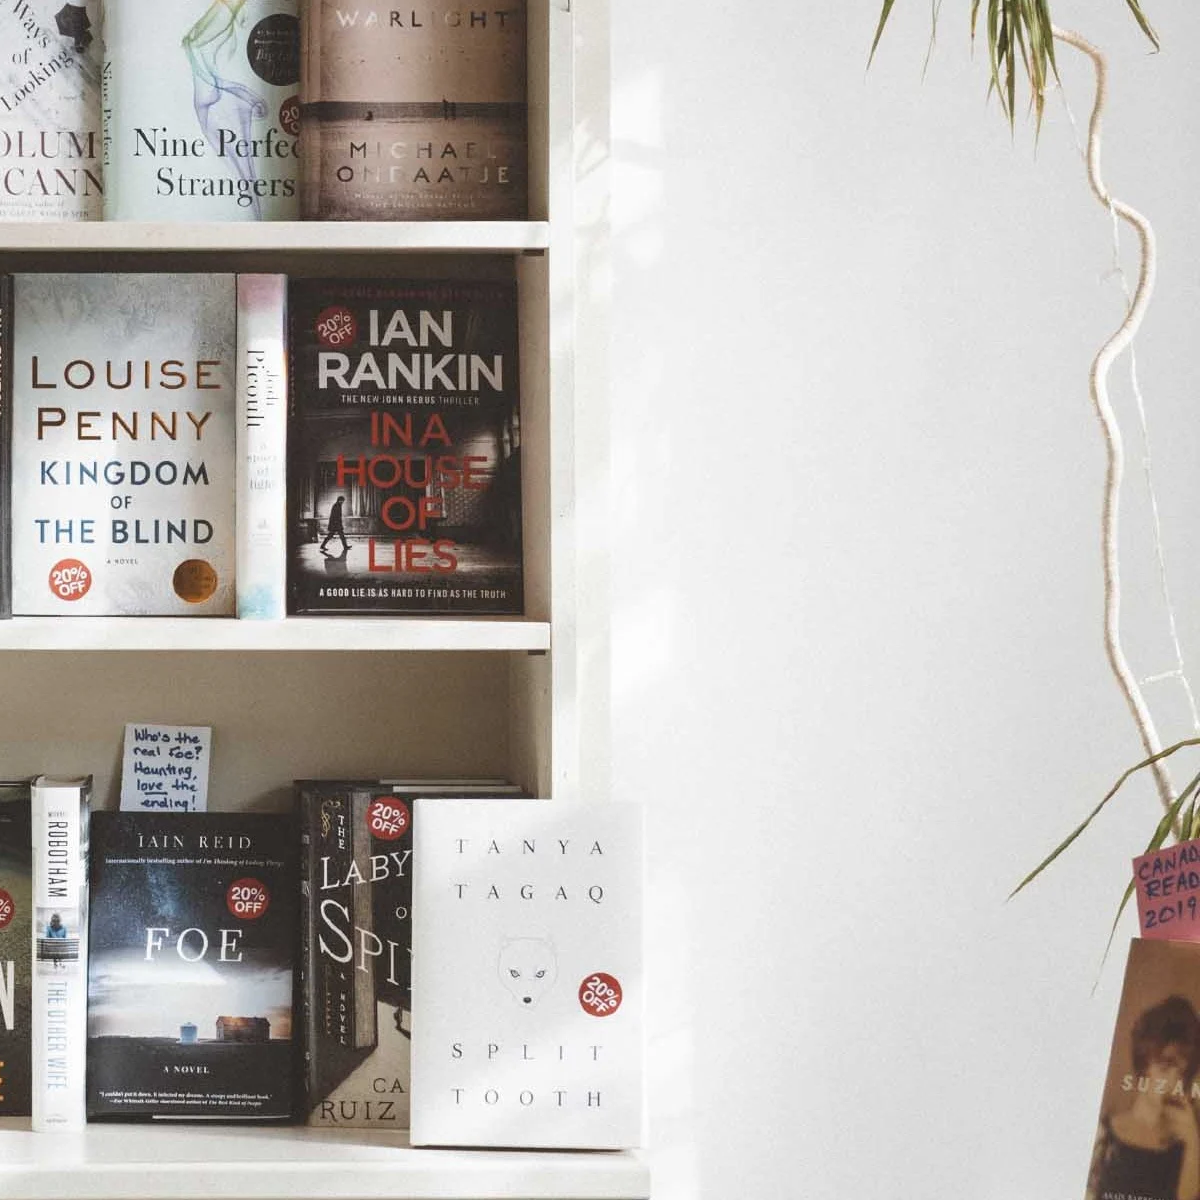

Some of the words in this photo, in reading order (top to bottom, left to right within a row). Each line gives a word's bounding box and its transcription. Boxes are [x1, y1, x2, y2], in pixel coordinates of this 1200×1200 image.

[12, 46, 31, 65] of
[0, 48, 75, 112] Looking
[133, 127, 206, 157] Nine
[217, 128, 300, 158] Perfec
[157, 166, 296, 206] Strangers
[369, 309, 452, 347] IAN
[32, 356, 222, 390] LOUISE
[318, 352, 503, 391] RANKIN
[37, 407, 213, 441] PENNY
[371, 411, 412, 447] IN
[420, 413, 451, 447] A
[40, 461, 210, 486] KINGDOM
[336, 453, 488, 490] HOUSE
[110, 496, 133, 509] OF
[381, 496, 444, 530] OF
[34, 519, 96, 543] THE
[112, 519, 214, 544] BLIND
[367, 538, 458, 574] LIES
[134, 729, 170, 744] Who's
[174, 731, 200, 744] the
[133, 747, 160, 758] real
[134, 763, 198, 781] Haunting,
[136, 780, 163, 793] love
[173, 781, 197, 793] the
[140, 797, 197, 812] ending!
[138, 832, 184, 849] IAIN
[199, 833, 252, 849] REID
[455, 838, 604, 855] TANYA
[1138, 846, 1200, 881] CANAD
[231, 885, 266, 901] 20%
[454, 884, 604, 904] TAGAQ
[234, 900, 262, 914] OFF
[1145, 896, 1197, 929] 2019
[144, 927, 243, 963] FOE
[581, 990, 609, 1013] OFF
[585, 975, 618, 1008] 20%
[451, 1043, 603, 1061] SPLIT
[451, 1088, 603, 1107] TOOTH
[320, 1100, 397, 1121] RUIZ
